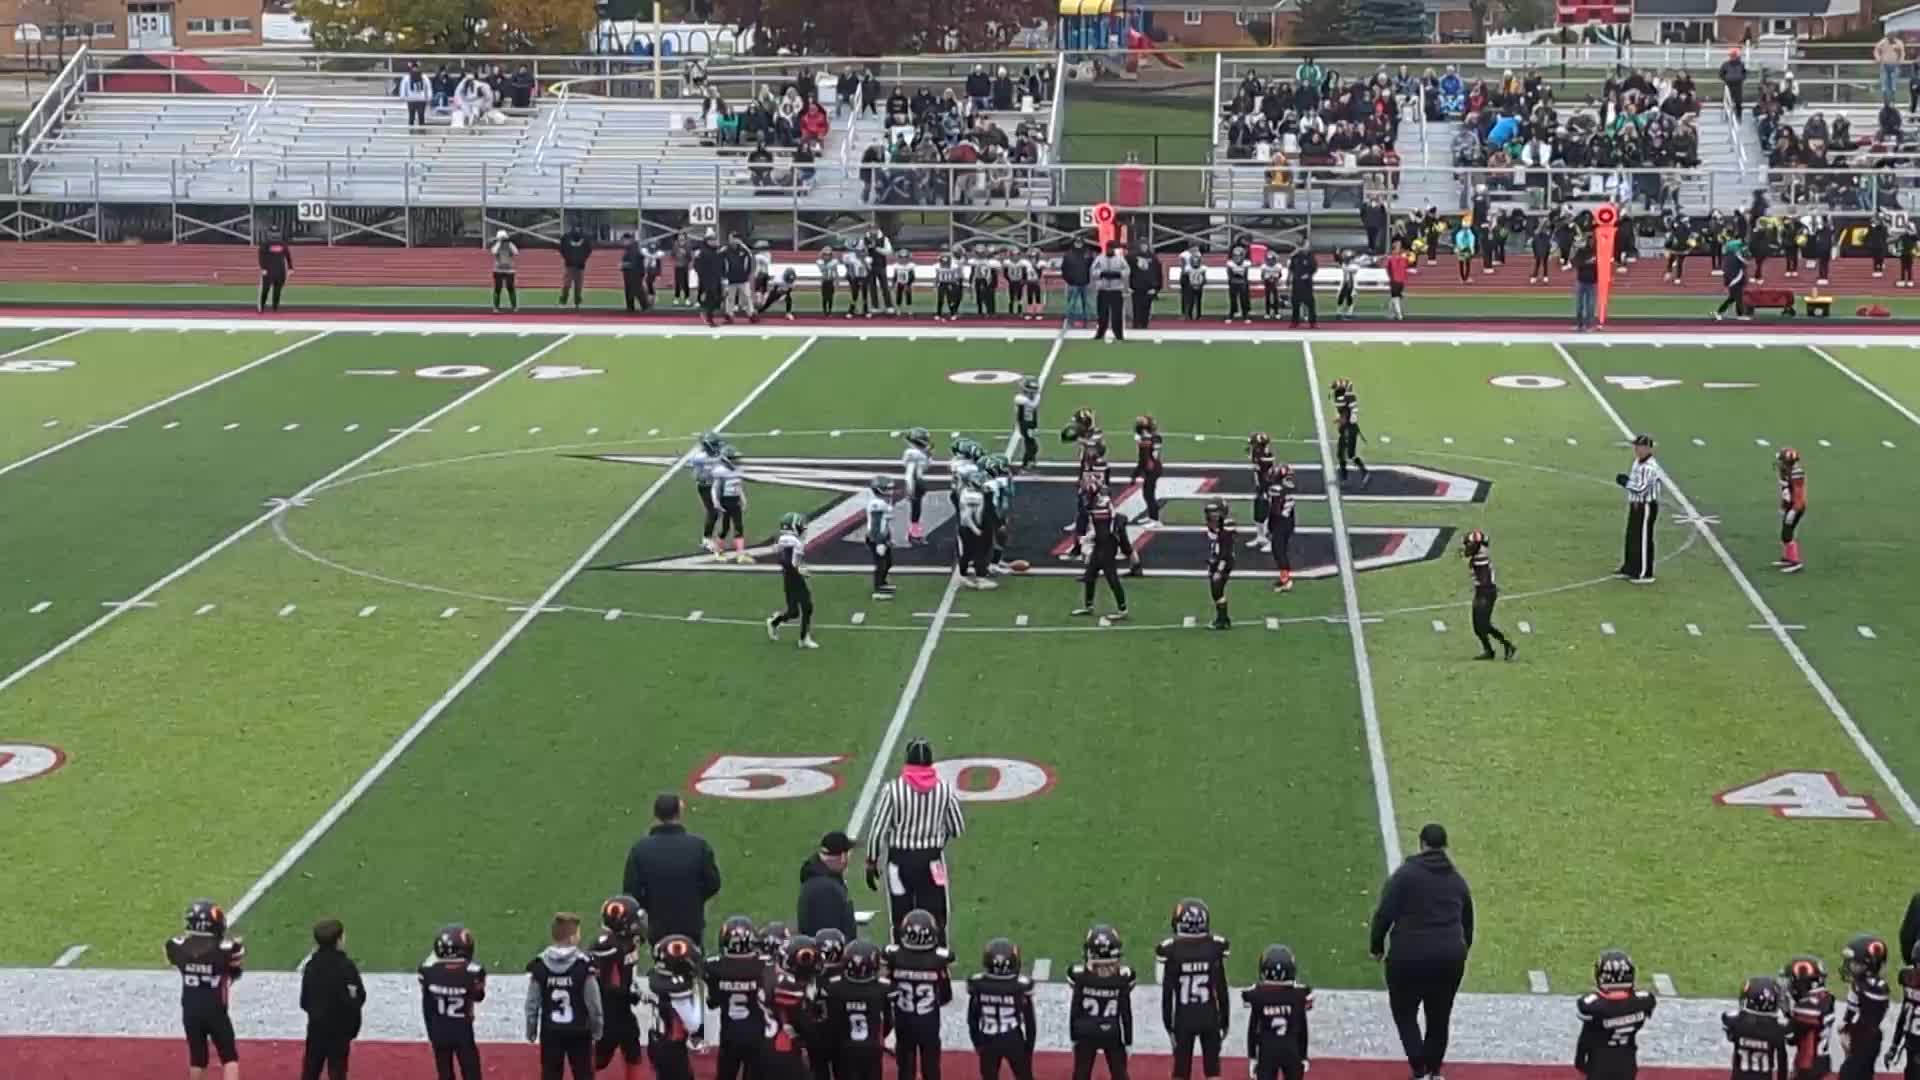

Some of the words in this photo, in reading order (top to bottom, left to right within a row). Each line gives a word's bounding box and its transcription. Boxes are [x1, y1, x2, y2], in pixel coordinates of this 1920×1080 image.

[300, 203, 322, 217] 30
[692, 206, 713, 221] 40
[1717, 770, 1889, 821] 4
[1179, 975, 1209, 1005] 15
[437, 997, 465, 1017] 12
[551, 989, 573, 1023] 3
